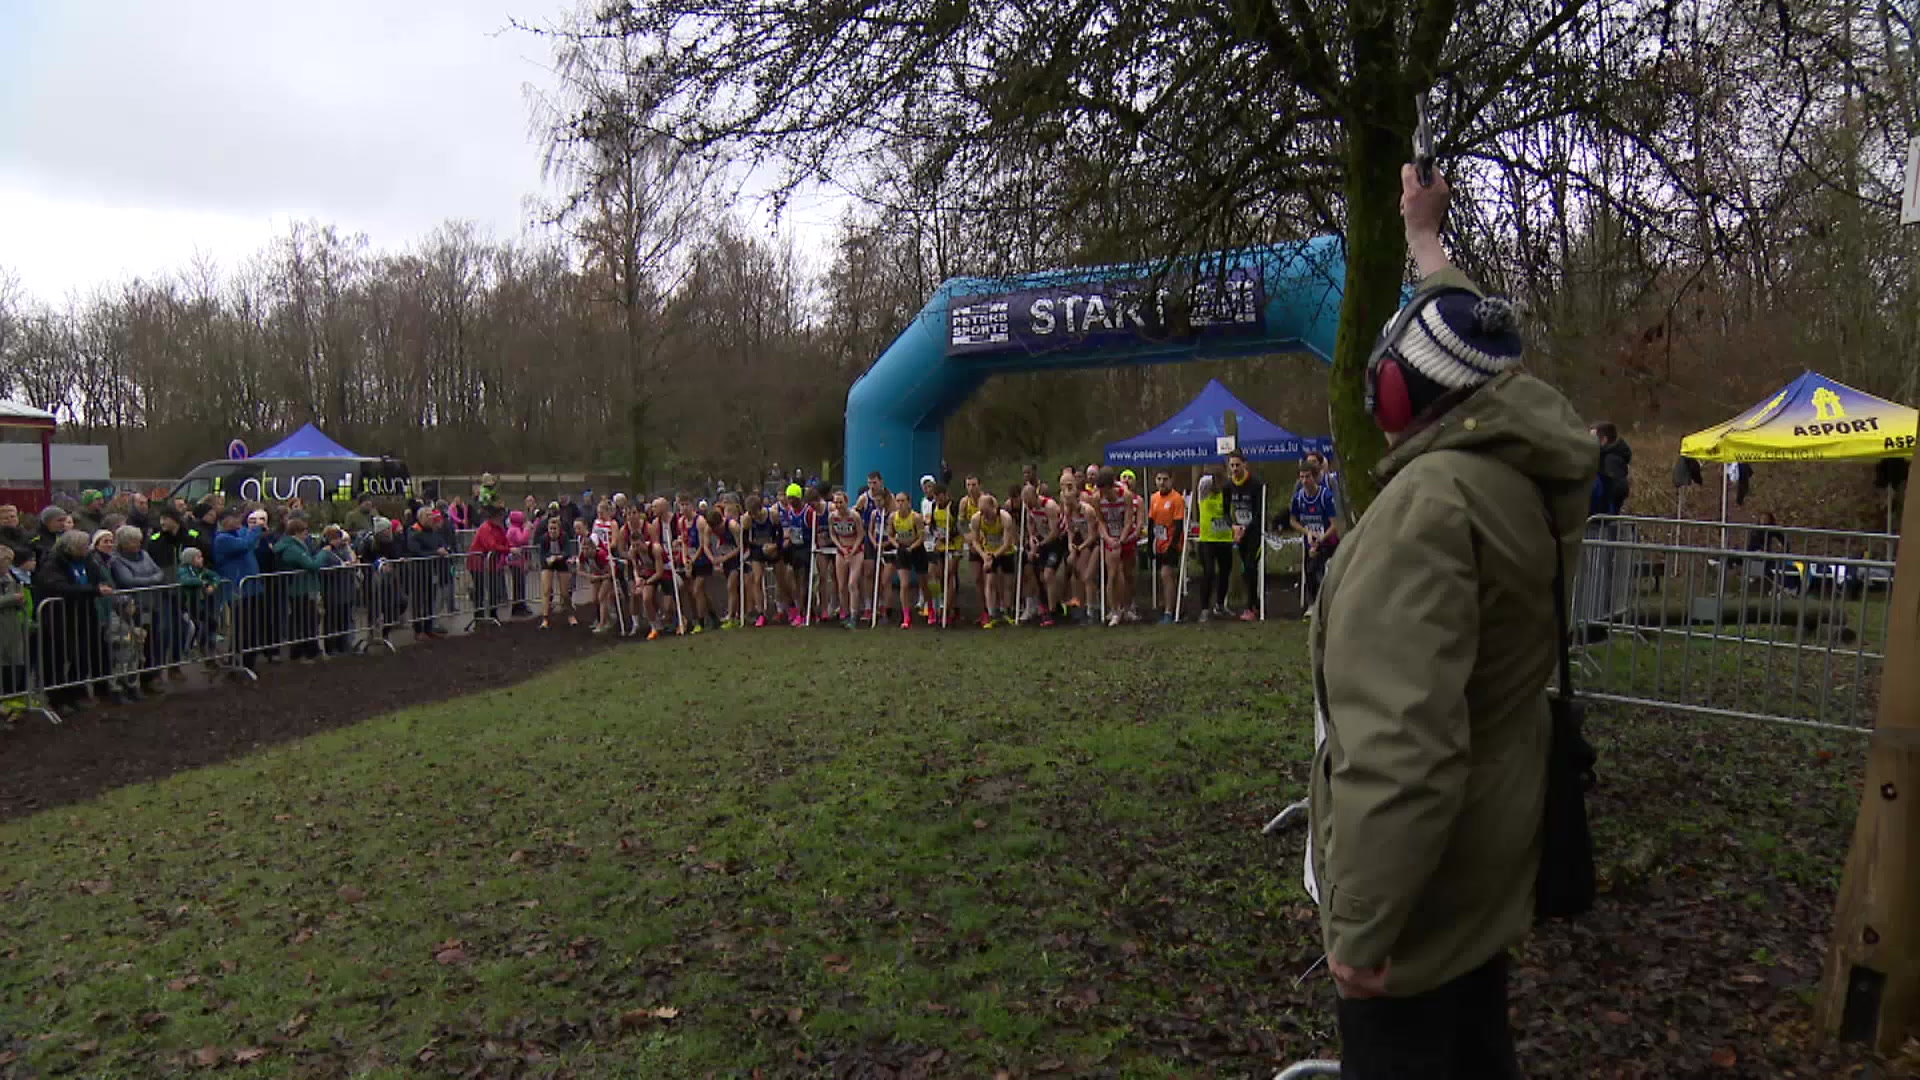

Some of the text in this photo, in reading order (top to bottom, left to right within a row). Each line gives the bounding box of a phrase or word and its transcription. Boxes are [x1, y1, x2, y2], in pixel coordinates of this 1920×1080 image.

[952, 323, 1009, 337] SPORTS
[1794, 417, 1879, 437] ASPORT
[1109, 448, 1208, 461] www.peters-sports.lu
